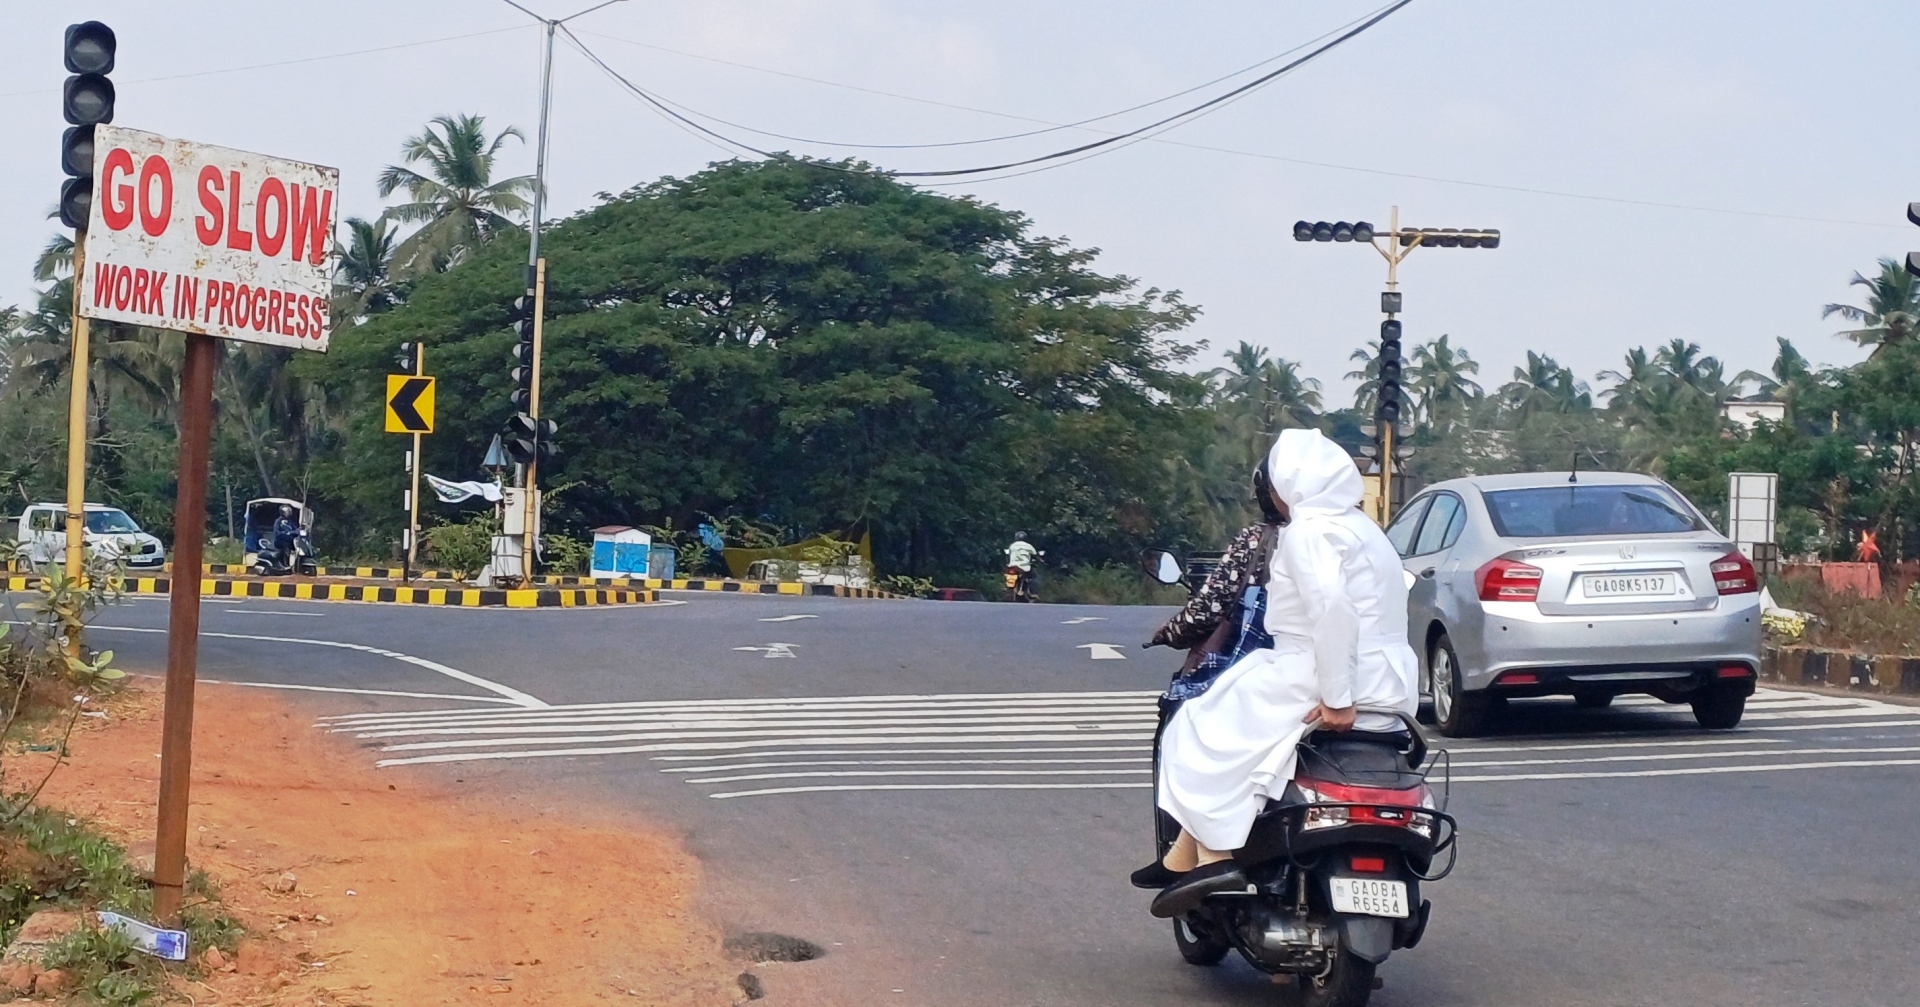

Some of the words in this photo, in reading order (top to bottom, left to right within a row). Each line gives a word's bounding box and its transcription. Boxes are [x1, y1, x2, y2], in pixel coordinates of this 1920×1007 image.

[102, 148, 173, 237] GO
[195, 165, 332, 266] SLOW
[94, 262, 167, 316] WORK
[173, 275, 198, 321] IN
[204, 279, 322, 340] PROGRESS
[1594, 577, 1665, 593] GA08K5137
[1352, 881, 1398, 898] GA08A
[1353, 896, 1400, 914] R6554
